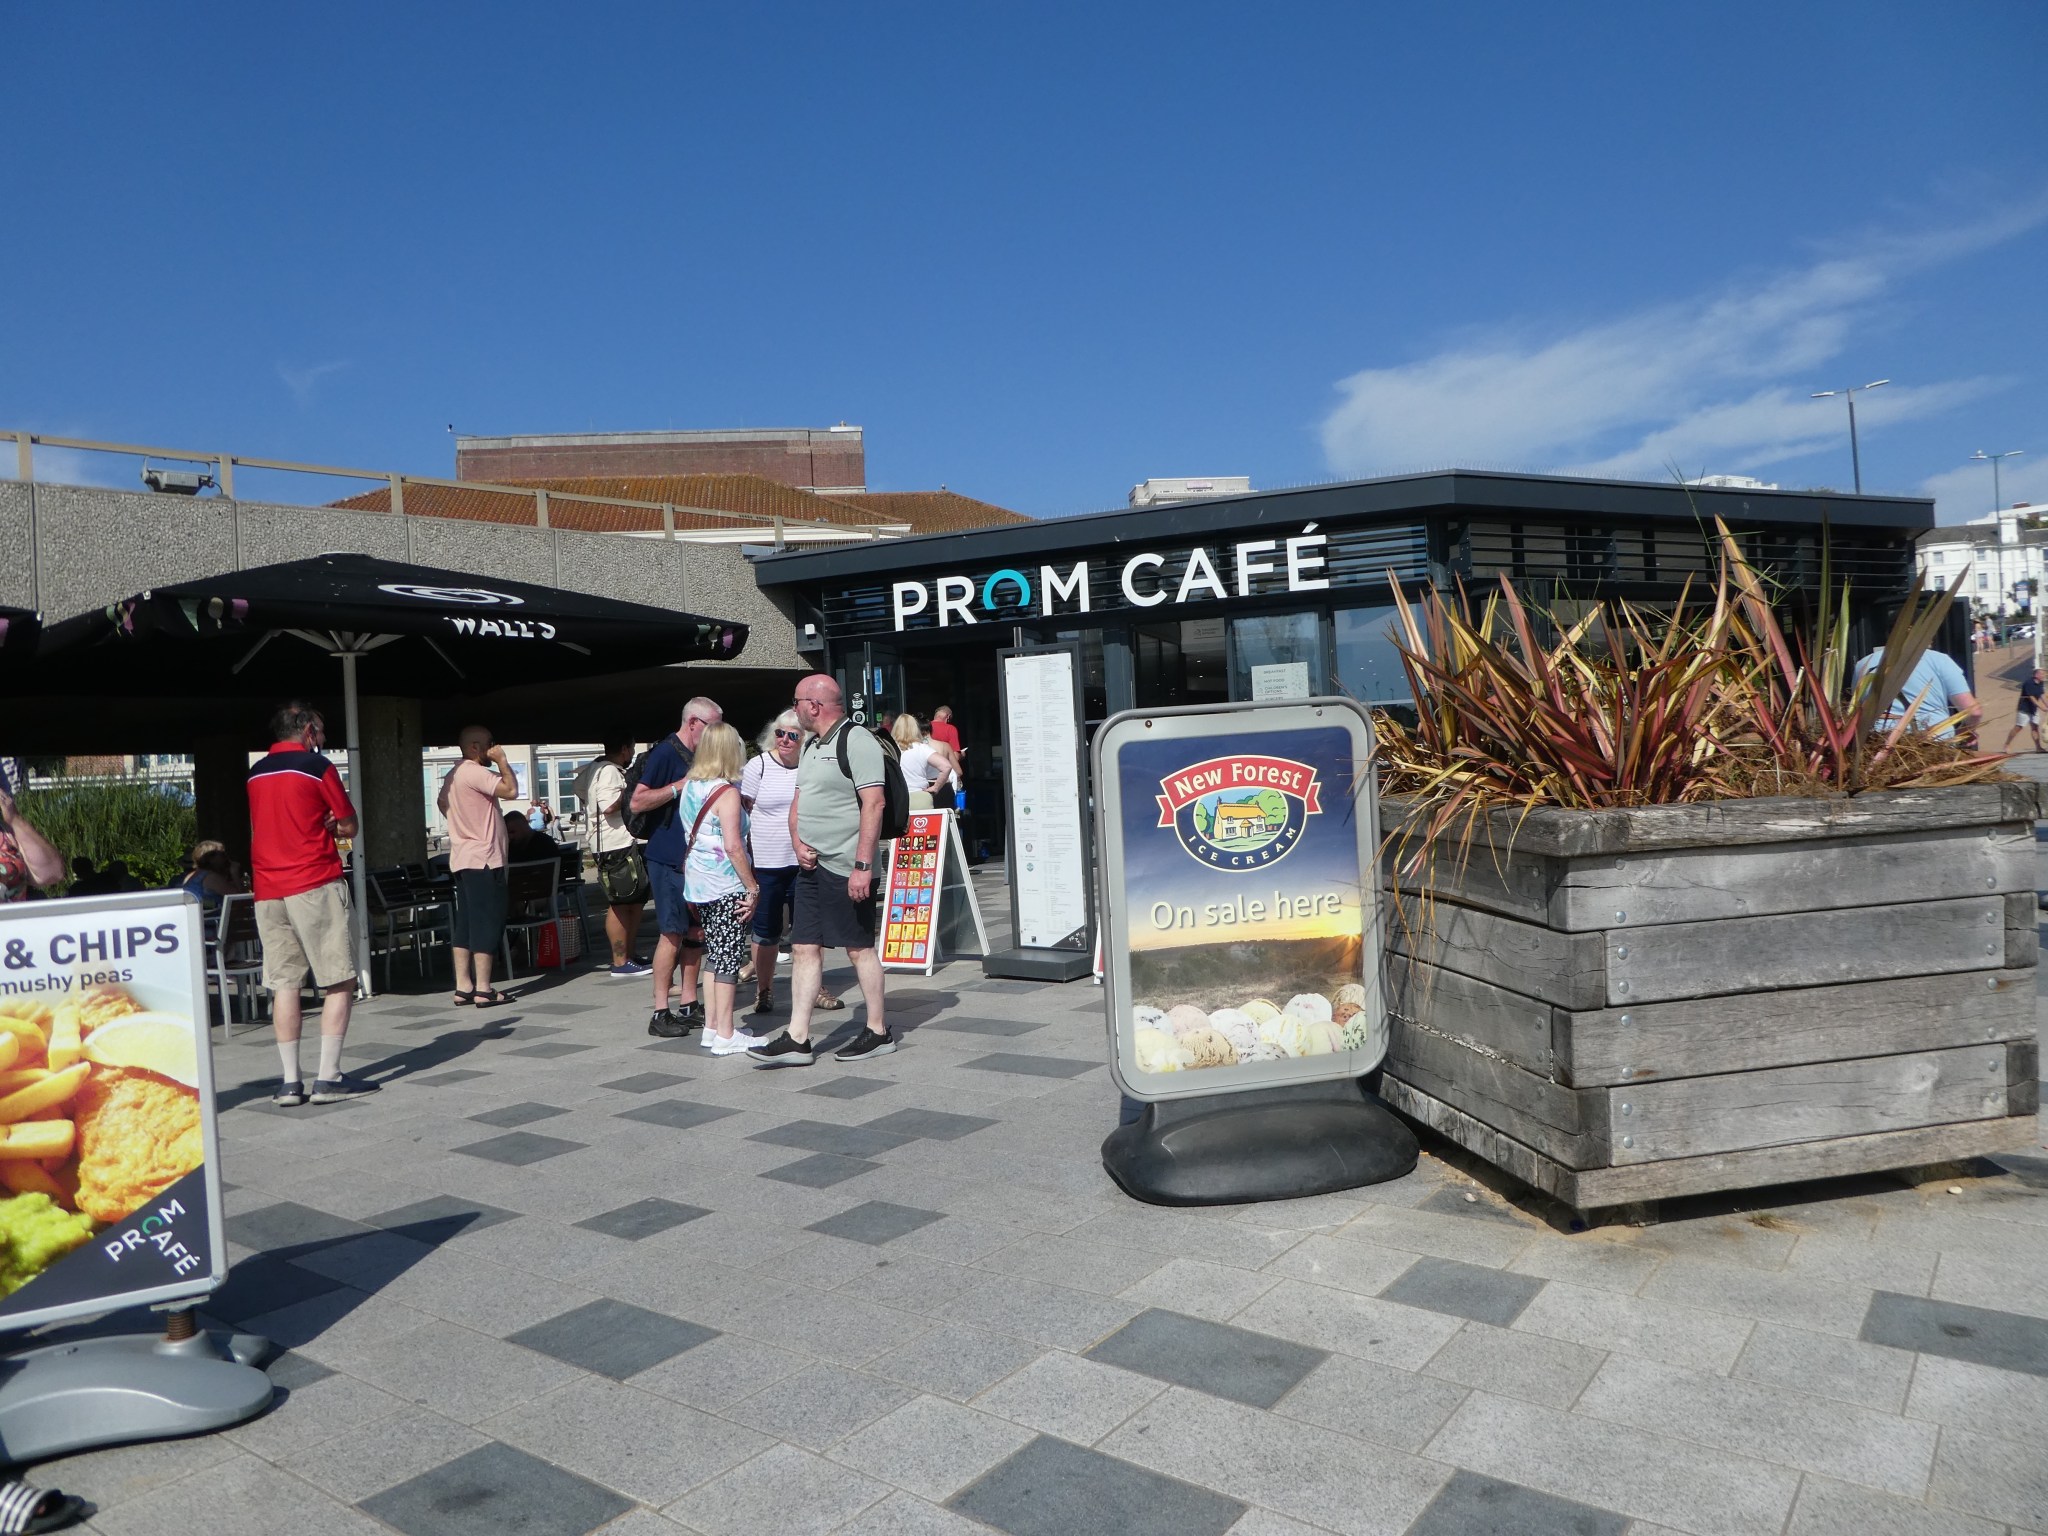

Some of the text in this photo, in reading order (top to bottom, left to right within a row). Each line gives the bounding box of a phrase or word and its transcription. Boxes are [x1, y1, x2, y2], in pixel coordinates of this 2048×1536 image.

[893, 521, 1330, 632] PROM CAFÉ
[1173, 762, 1303, 799] New Forest
[1188, 827, 1297, 865] ICE CREAM
[1150, 890, 1341, 930] On sale here
[3, 923, 180, 970] & CHIPS
[0, 968, 133, 996] mushy peas
[104, 1198, 186, 1262] PROM
